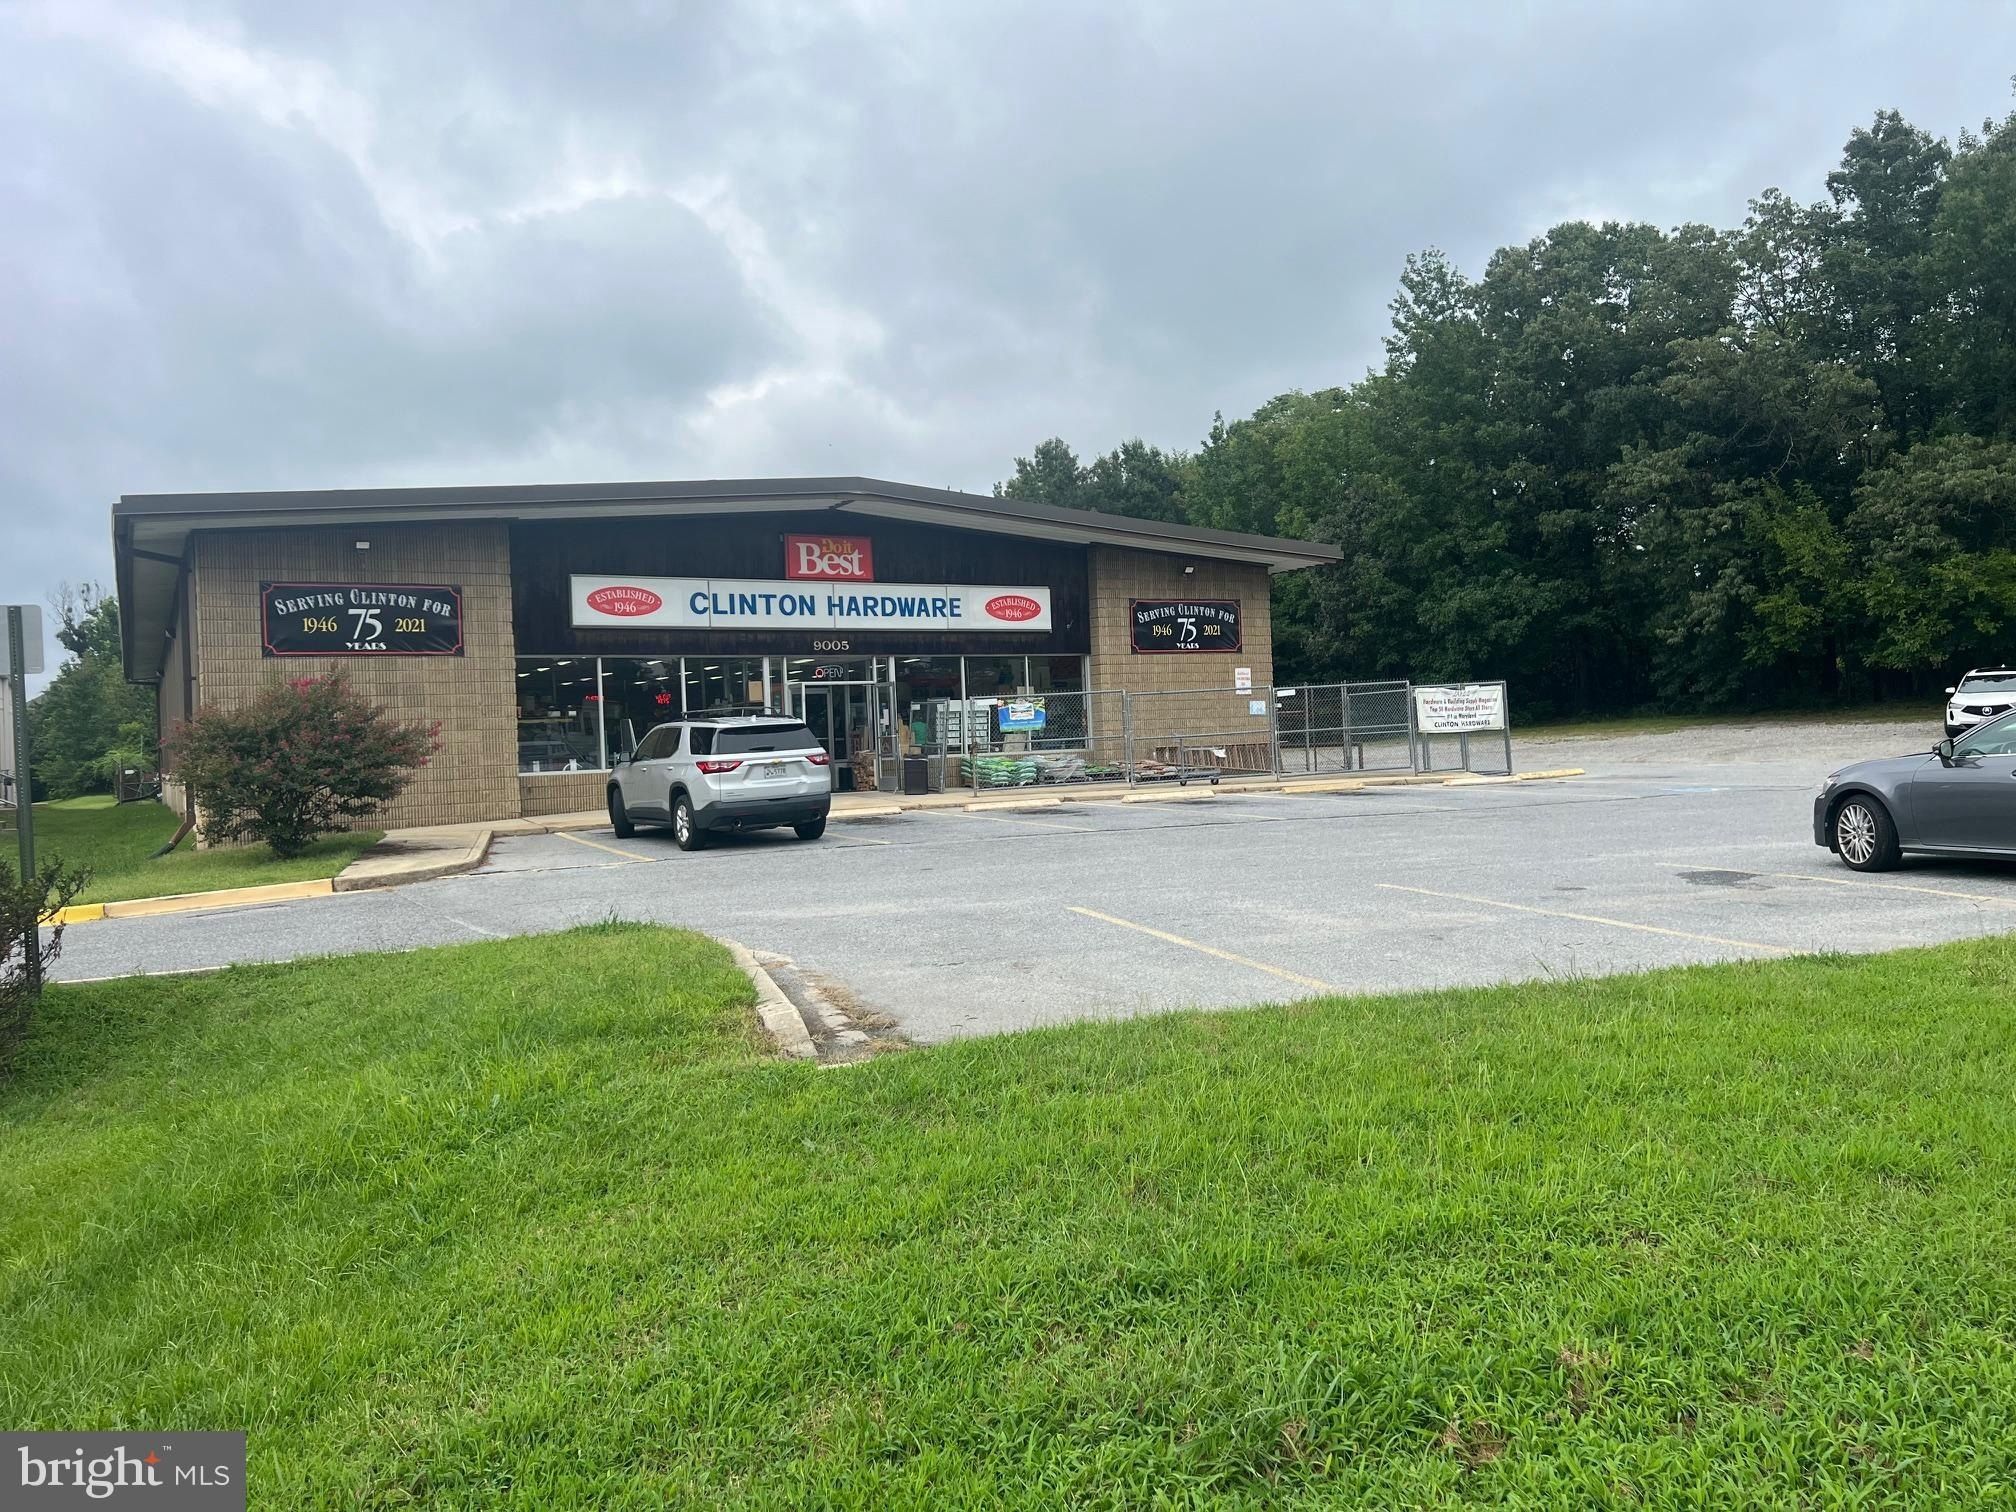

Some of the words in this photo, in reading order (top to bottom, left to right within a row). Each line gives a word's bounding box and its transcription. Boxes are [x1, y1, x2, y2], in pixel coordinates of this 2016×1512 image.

[795, 542, 865, 576] Best
[595, 589, 655, 604] ESTABLISHED
[614, 601, 637, 613] 1946
[689, 592, 816, 616] CLINTON
[827, 595, 962, 618] HARDWARE
[991, 598, 1036, 611] ESTABLISHED
[1005, 608, 1023, 619] 1946
[302, 616, 338, 634] 1946
[347, 608, 383, 641] 75
[394, 618, 426, 633] 2021
[1152, 624, 1172, 637] 1946
[1177, 618, 1197, 642] 75
[1203, 624, 1221, 636] 2021
[345, 641, 387, 650] YEARS
[813, 640, 850, 651] 9005
[815, 668, 842, 678] OPEN
